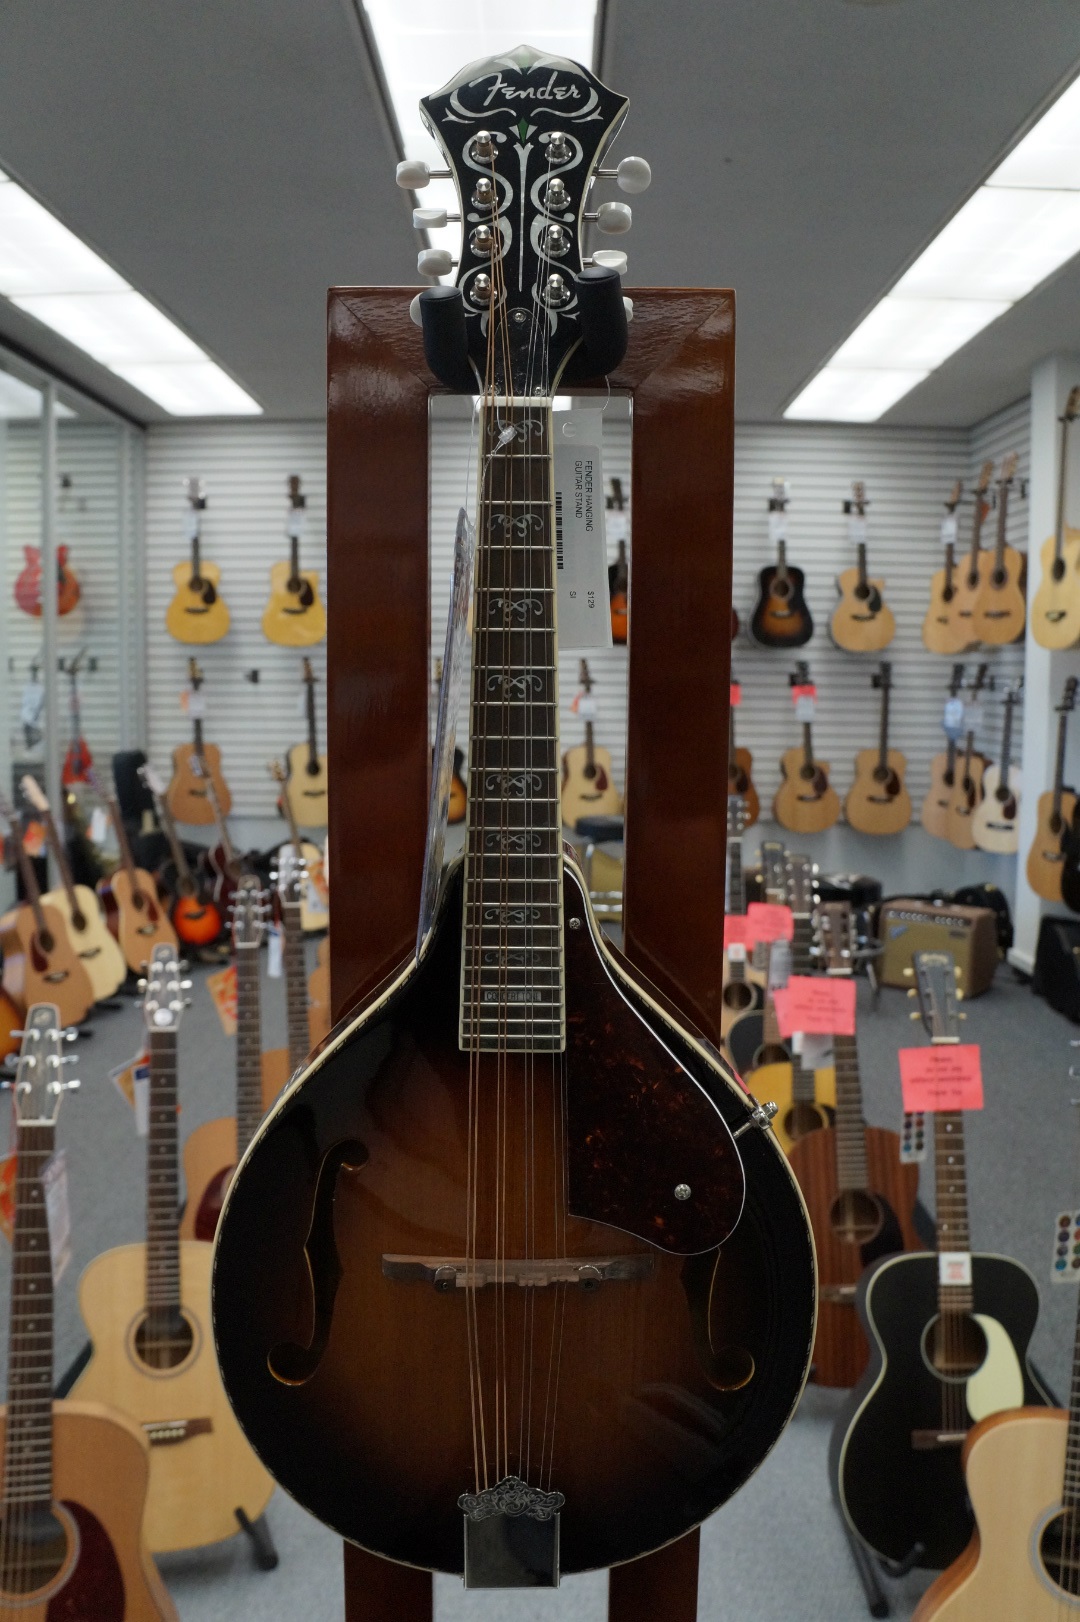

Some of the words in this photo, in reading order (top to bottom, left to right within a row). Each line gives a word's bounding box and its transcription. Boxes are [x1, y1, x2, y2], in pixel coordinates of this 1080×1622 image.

[469, 71, 581, 106] Fender
[575, 461, 583, 491] GUITAR
[585, 461, 593, 493] FENDER
[575, 492, 583, 519] STAND
[585, 495, 594, 532] HANGING
[587, 591, 595, 609] $129
